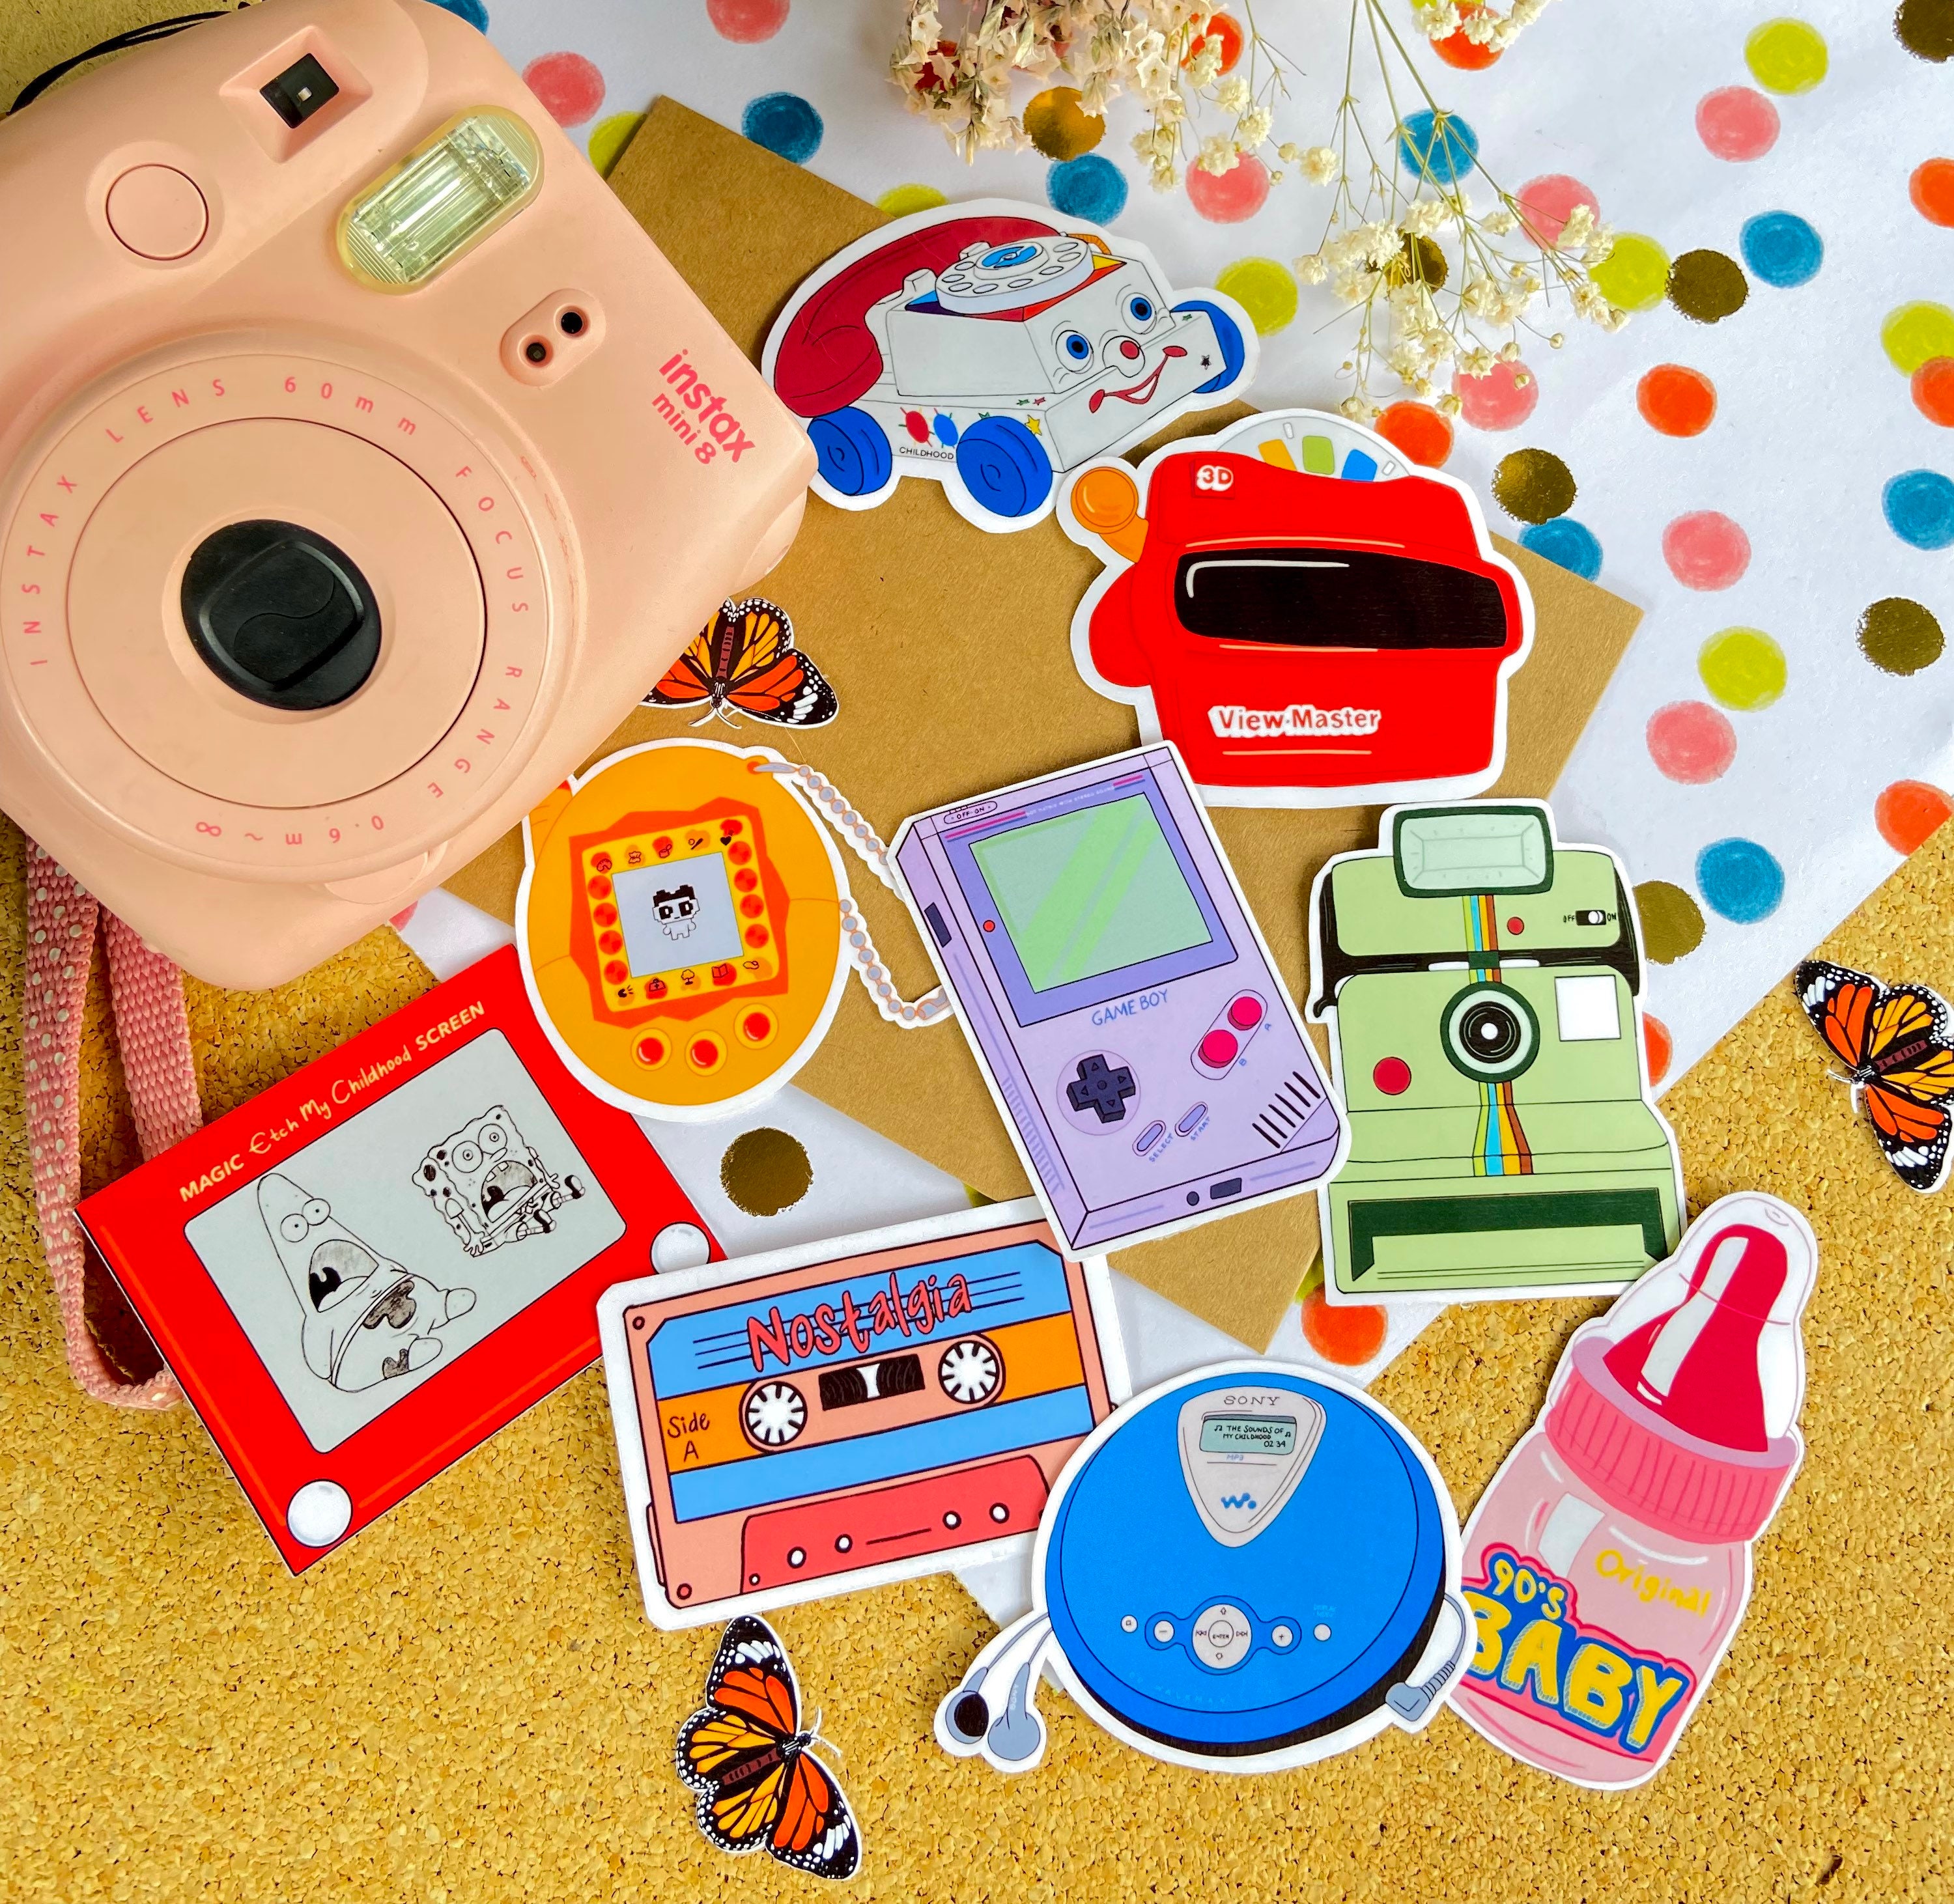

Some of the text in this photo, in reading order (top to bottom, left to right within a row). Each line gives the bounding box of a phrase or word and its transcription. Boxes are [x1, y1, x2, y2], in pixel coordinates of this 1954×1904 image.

[658, 348, 756, 463] instax
[651, 393, 716, 464] mini 8
[899, 446, 954, 460] CHILDHOOD
[1202, 468, 1232, 484] 3D
[23, 376, 418, 665] INSTAX LENS 60mm
[455, 465, 530, 613] FOCUS
[427, 664, 522, 799] RANGE
[1563, 914, 1575, 923] OFF
[1092, 988, 1168, 1026] GAME BOY
[1264, 1023, 1272, 1031] A
[1239, 1058, 1247, 1067] B
[179, 1000, 485, 1202] MAGIC Etch My Childhood SCREEN
[1191, 1116, 1210, 1141] START
[1149, 1132, 1173, 1162] SELECT
[746, 1272, 972, 1373] Nostalgia
[1224, 1395, 1281, 1406] SONY
[667, 1411, 710, 1438] Side
[1243, 1425, 1273, 1433] SOUNDS
[683, 1440, 699, 1463] A
[1594, 1549, 1712, 1618] Original
[1462, 1591, 1682, 1748] BABY
